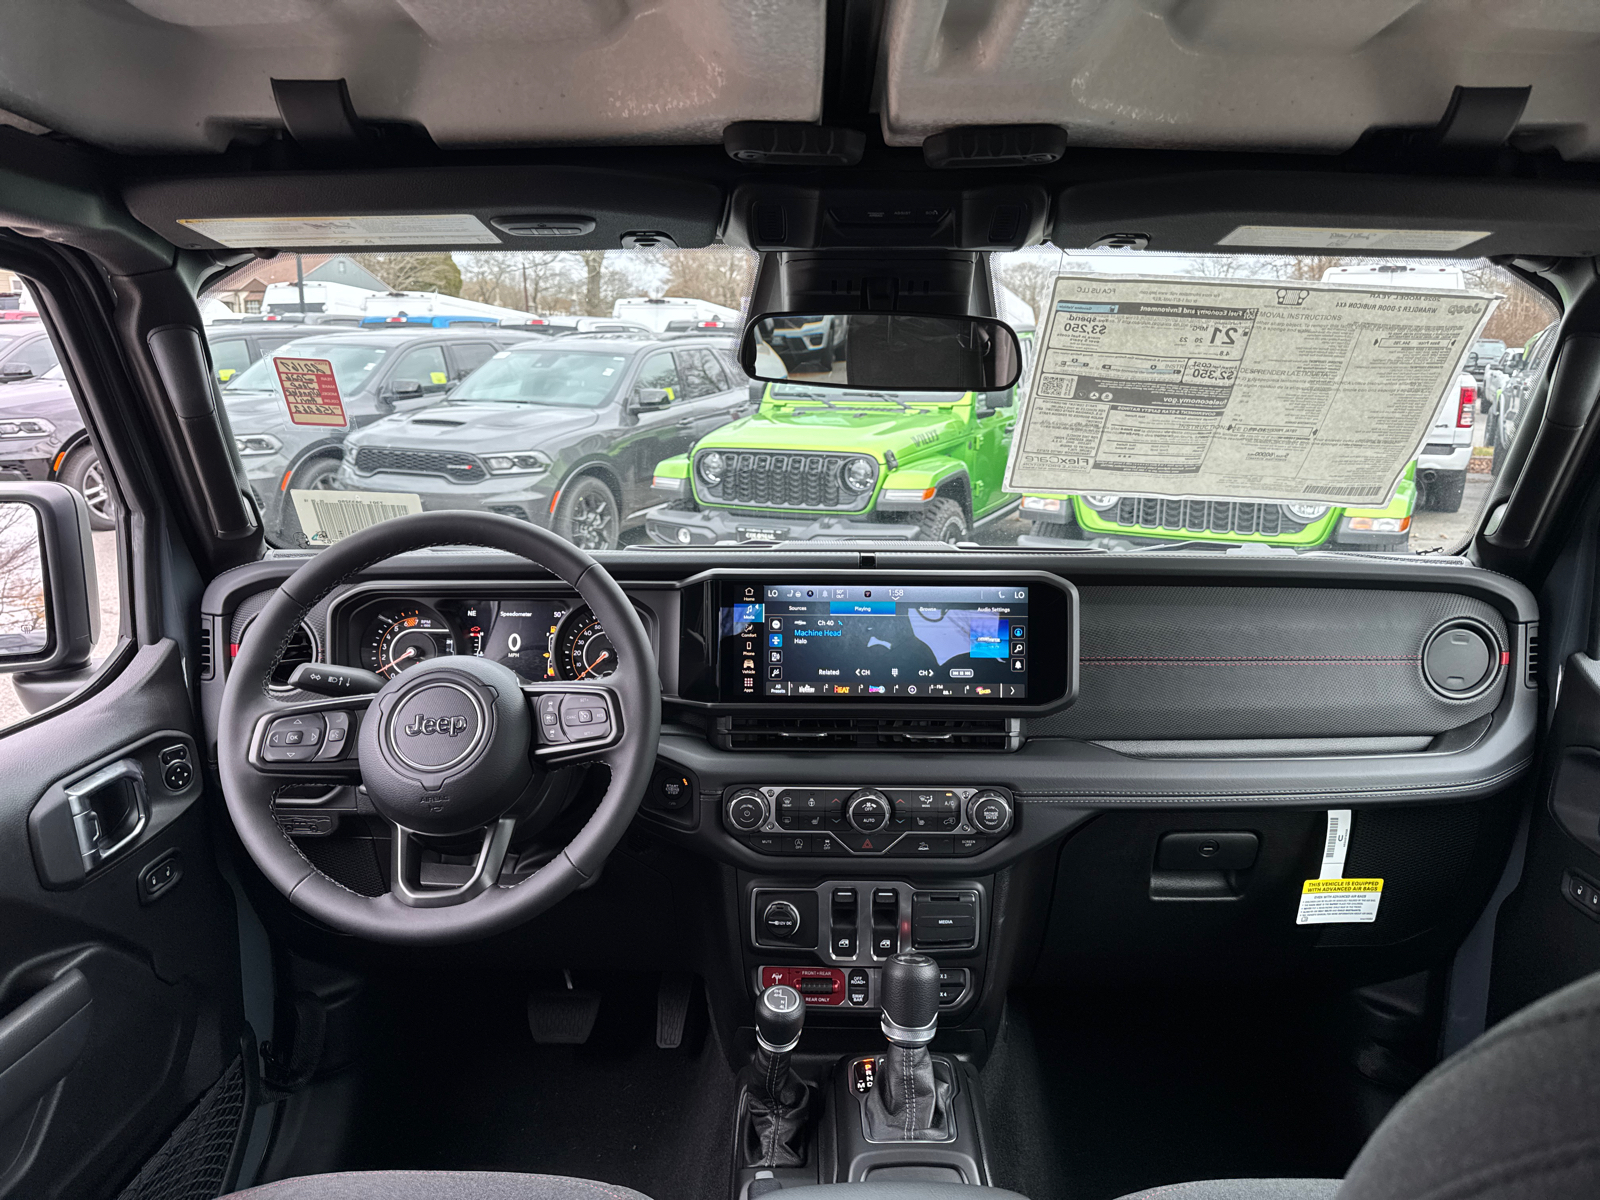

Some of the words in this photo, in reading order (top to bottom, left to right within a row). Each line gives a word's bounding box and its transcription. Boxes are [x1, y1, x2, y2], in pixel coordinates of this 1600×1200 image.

[1287, 313, 1342, 321] INSTRUCTIONS
[508, 633, 521, 651] 0
[405, 714, 467, 737] Jeep
